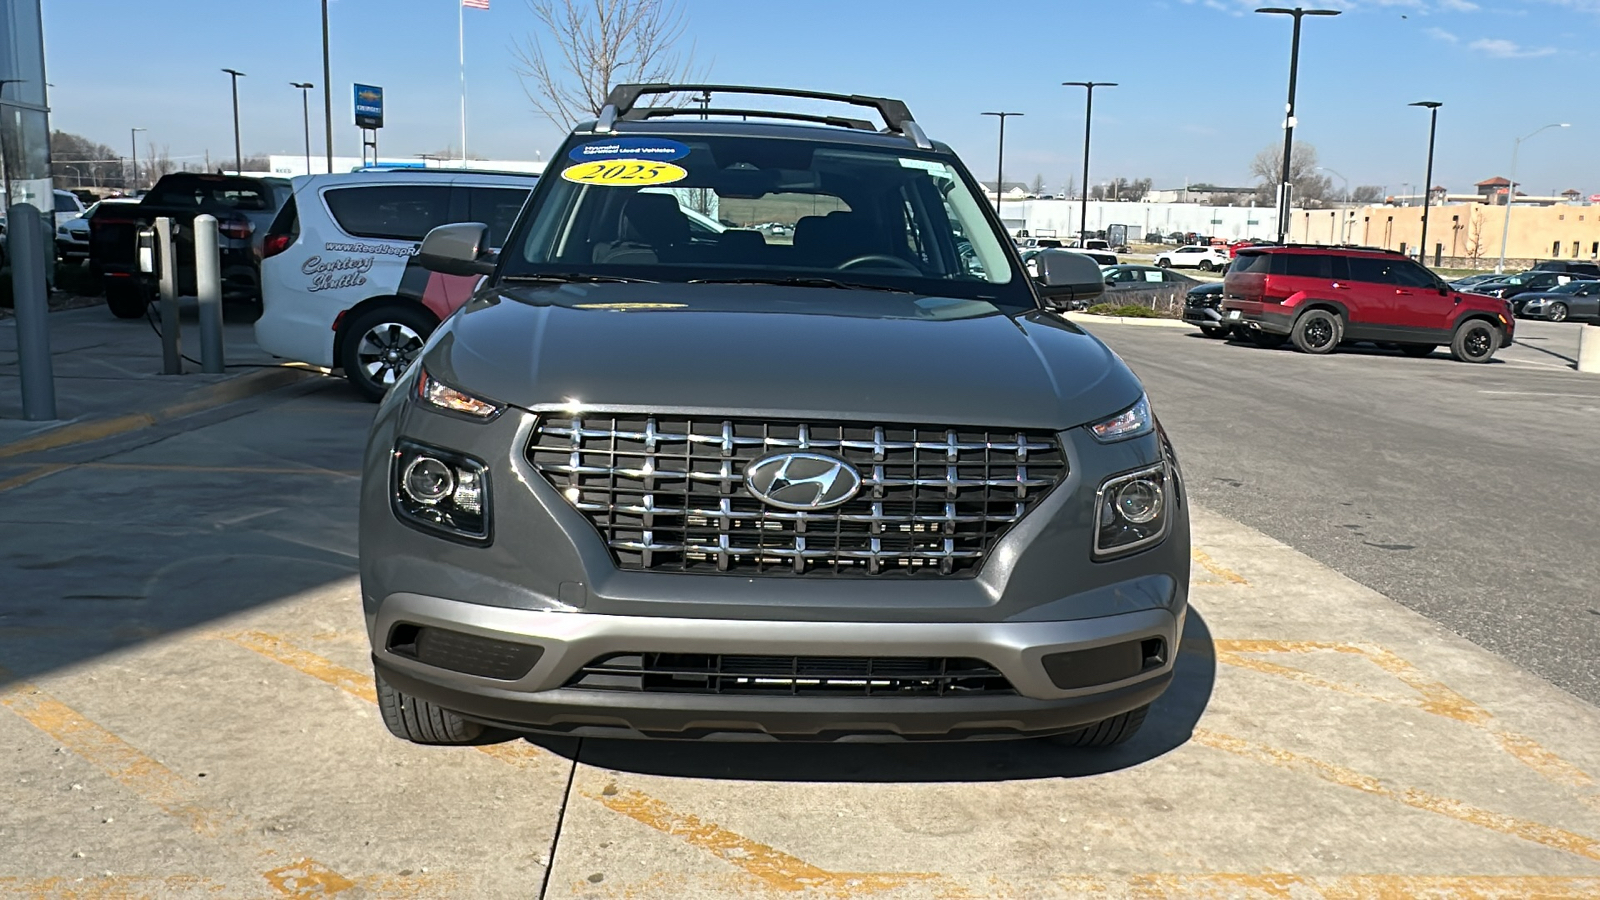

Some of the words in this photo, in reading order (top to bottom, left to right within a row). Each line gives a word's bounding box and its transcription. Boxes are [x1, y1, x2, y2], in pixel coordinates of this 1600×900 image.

[579, 164, 667, 180] 2025
[301, 255, 375, 275] Courtesy
[306, 271, 367, 292] Shuttle
